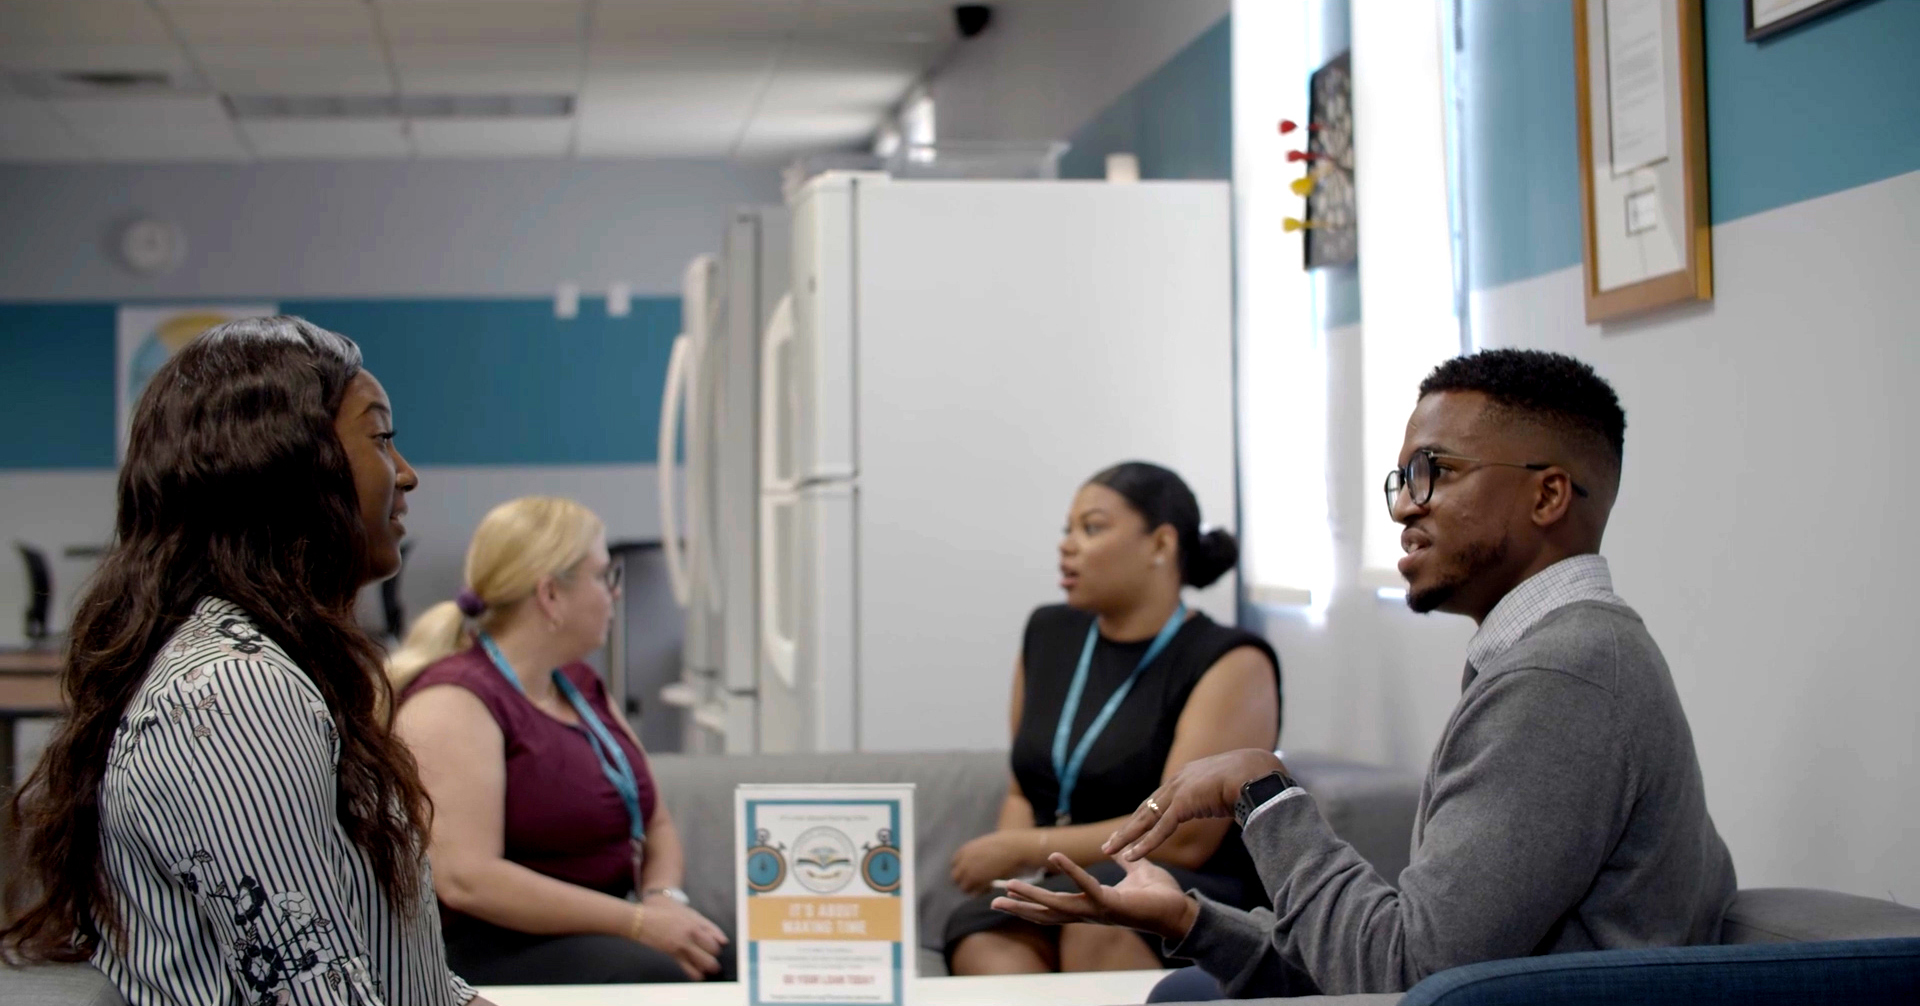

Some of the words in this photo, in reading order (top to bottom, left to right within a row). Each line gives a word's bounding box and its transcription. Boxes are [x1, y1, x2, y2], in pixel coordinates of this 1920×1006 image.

[817, 903, 860, 917] ABOUT
[782, 919, 833, 934] MAKING
[836, 919, 867, 934] TIME
